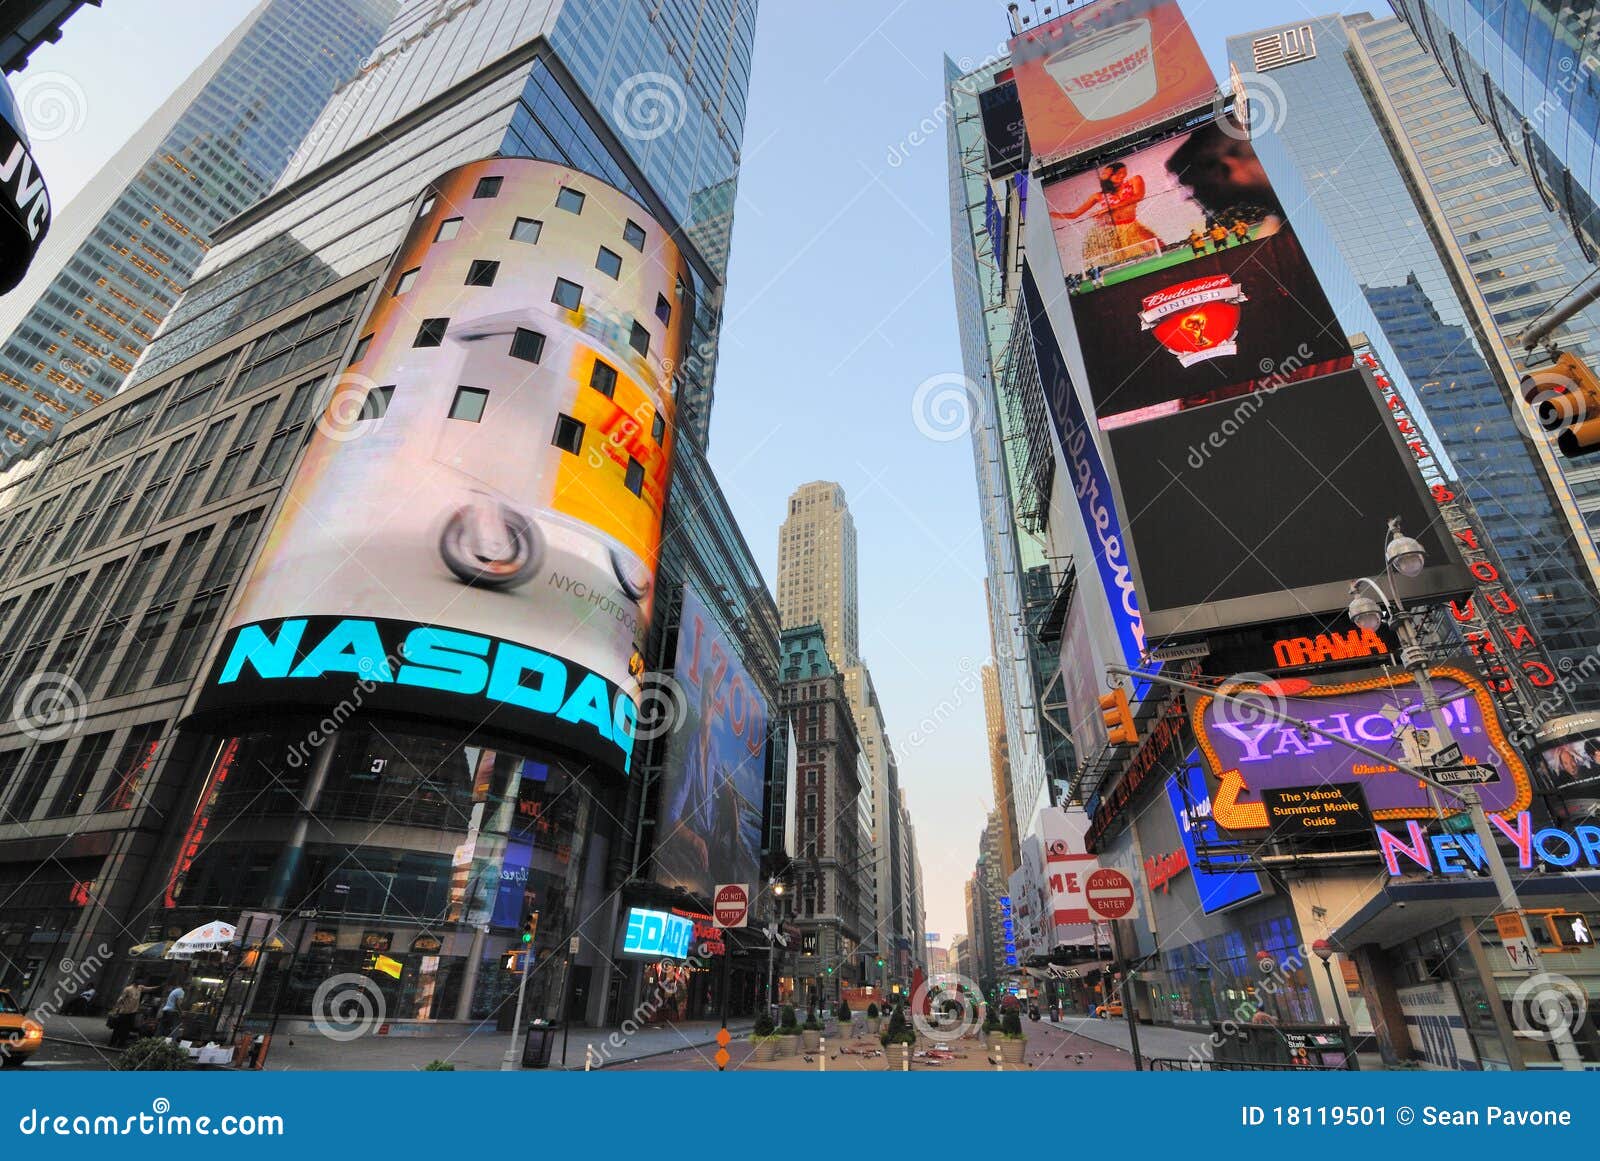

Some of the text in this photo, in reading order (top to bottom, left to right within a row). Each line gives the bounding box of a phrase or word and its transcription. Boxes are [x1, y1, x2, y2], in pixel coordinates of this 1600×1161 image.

[0, 142, 49, 241] JVC
[1143, 276, 1229, 306] Budweiser
[1158, 290, 1221, 314] UNITED
[548, 572, 637, 634] NYC HOT DOG
[1153, 647, 1207, 660] SHERWOOD
[688, 614, 763, 758] IZOD
[217, 619, 638, 775] NASDAQ
[1212, 697, 1469, 762] YAHOO!
[1440, 767, 1488, 781] ONE WAY
[1280, 789, 1342, 803] The Yahoo!
[1273, 802, 1360, 816] Summer Movie
[1302, 816, 1337, 828] Guide
[1092, 877, 1123, 887] DO NOT
[720, 892, 742, 901] DO NOT
[1098, 900, 1125, 909] ENTER
[720, 911, 742, 920] ENTER
[803, 937, 816, 949] GAP
